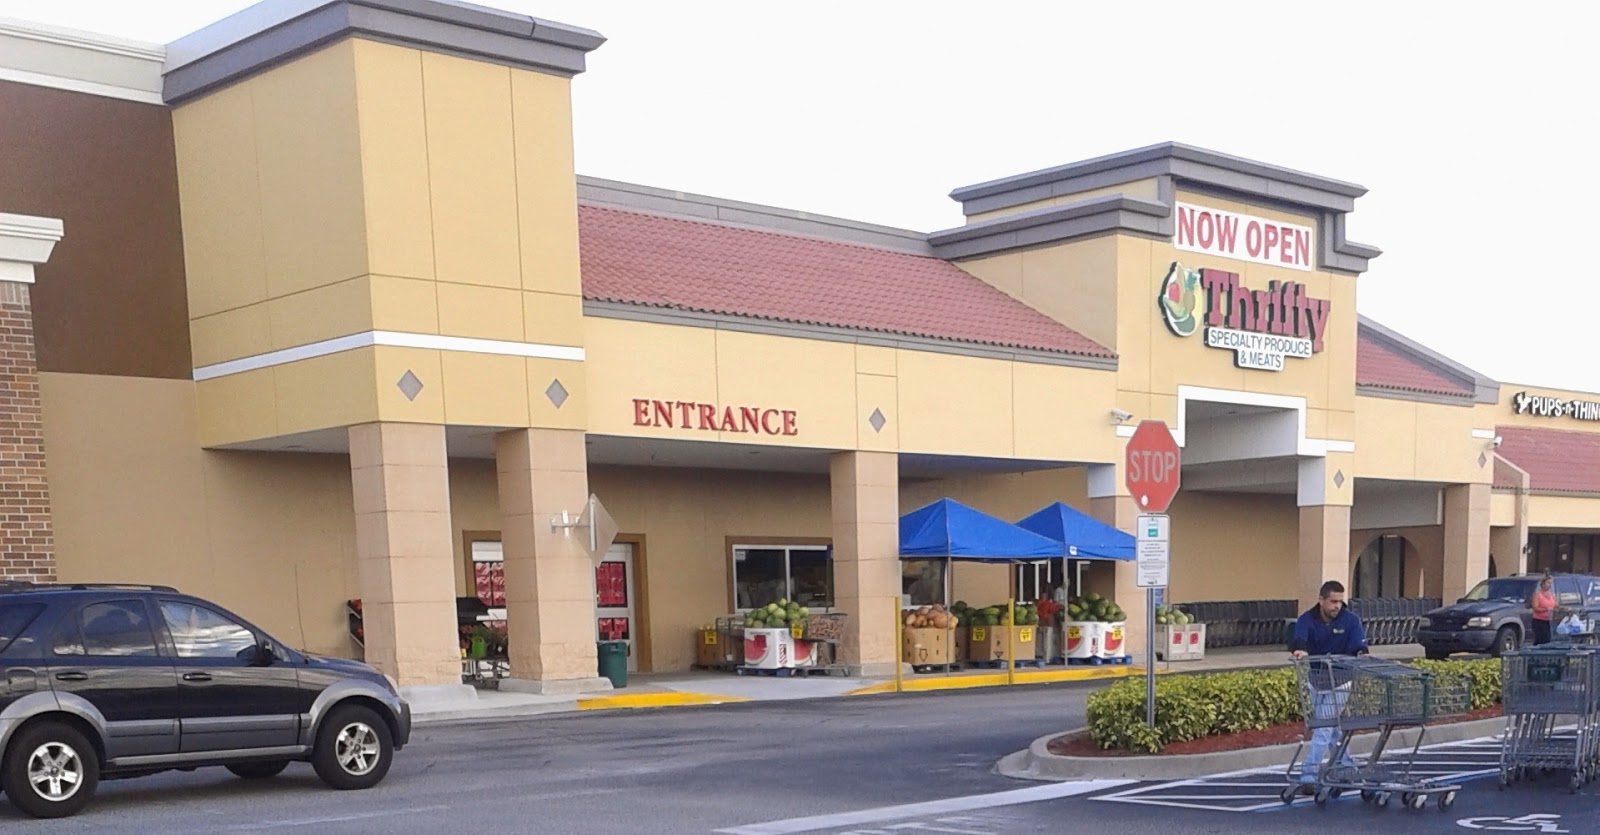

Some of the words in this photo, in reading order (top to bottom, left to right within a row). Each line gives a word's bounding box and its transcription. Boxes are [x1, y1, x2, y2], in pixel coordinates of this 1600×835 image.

[1178, 206, 1238, 253] NOW
[1246, 220, 1310, 267] OPEN
[1200, 268, 1331, 353] Thrifty
[1210, 329, 1262, 349] SPECIALTY
[1264, 337, 1310, 355] PRODUCE
[1240, 350, 1247, 364] &
[1249, 351, 1281, 368] MEATS
[632, 398, 798, 436] ENTRANCE
[1532, 396, 1600, 420] PUPS-n-THIN
[1129, 450, 1176, 484] STOP
